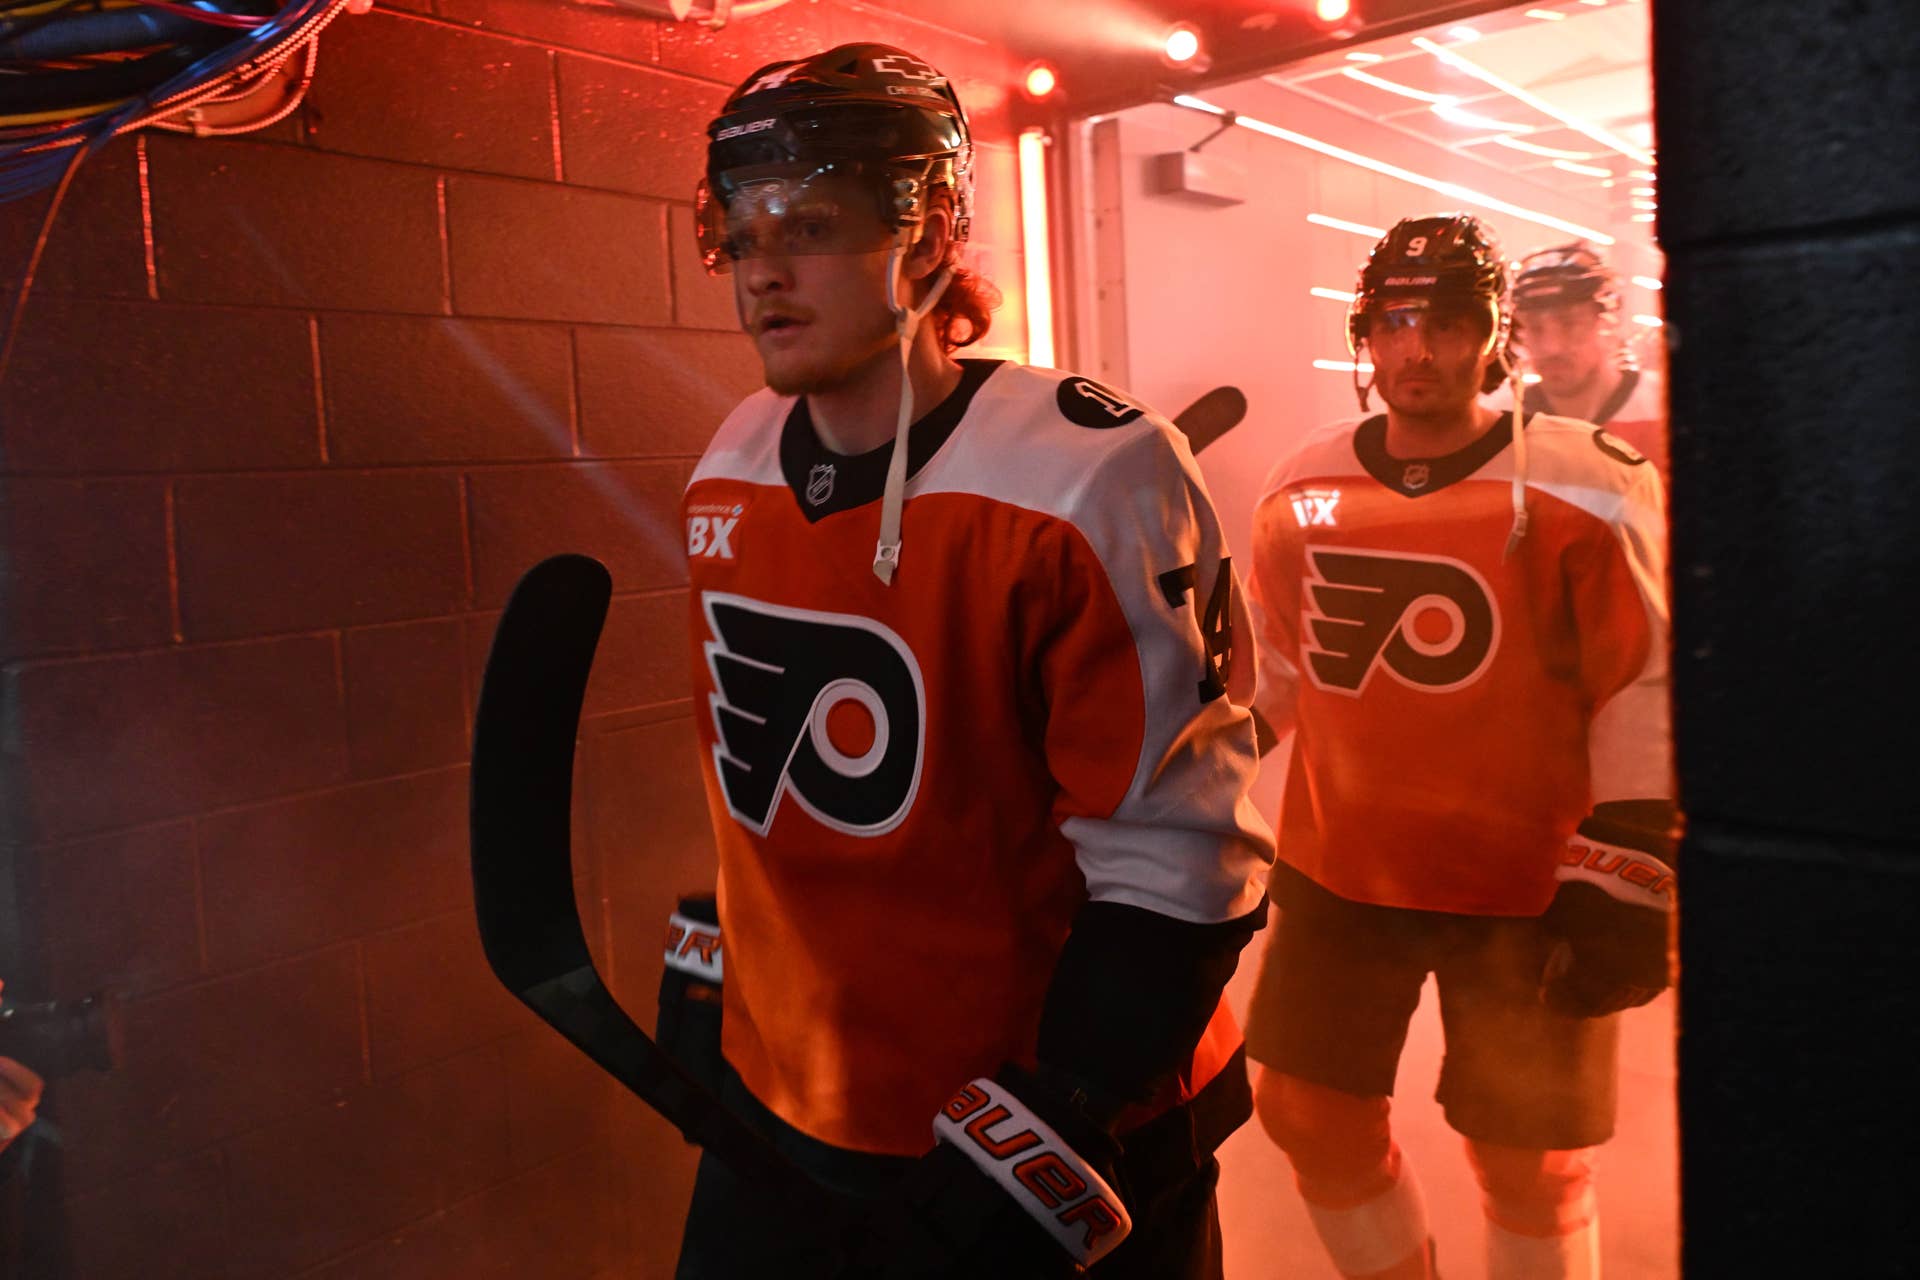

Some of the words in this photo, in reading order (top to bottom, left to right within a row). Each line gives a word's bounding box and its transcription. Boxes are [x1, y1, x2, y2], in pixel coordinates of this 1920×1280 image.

[716, 118, 776, 141] BAUER
[1405, 236, 1428, 257] 9
[687, 516, 740, 560] BX
[942, 1084, 1121, 1250] AUER
